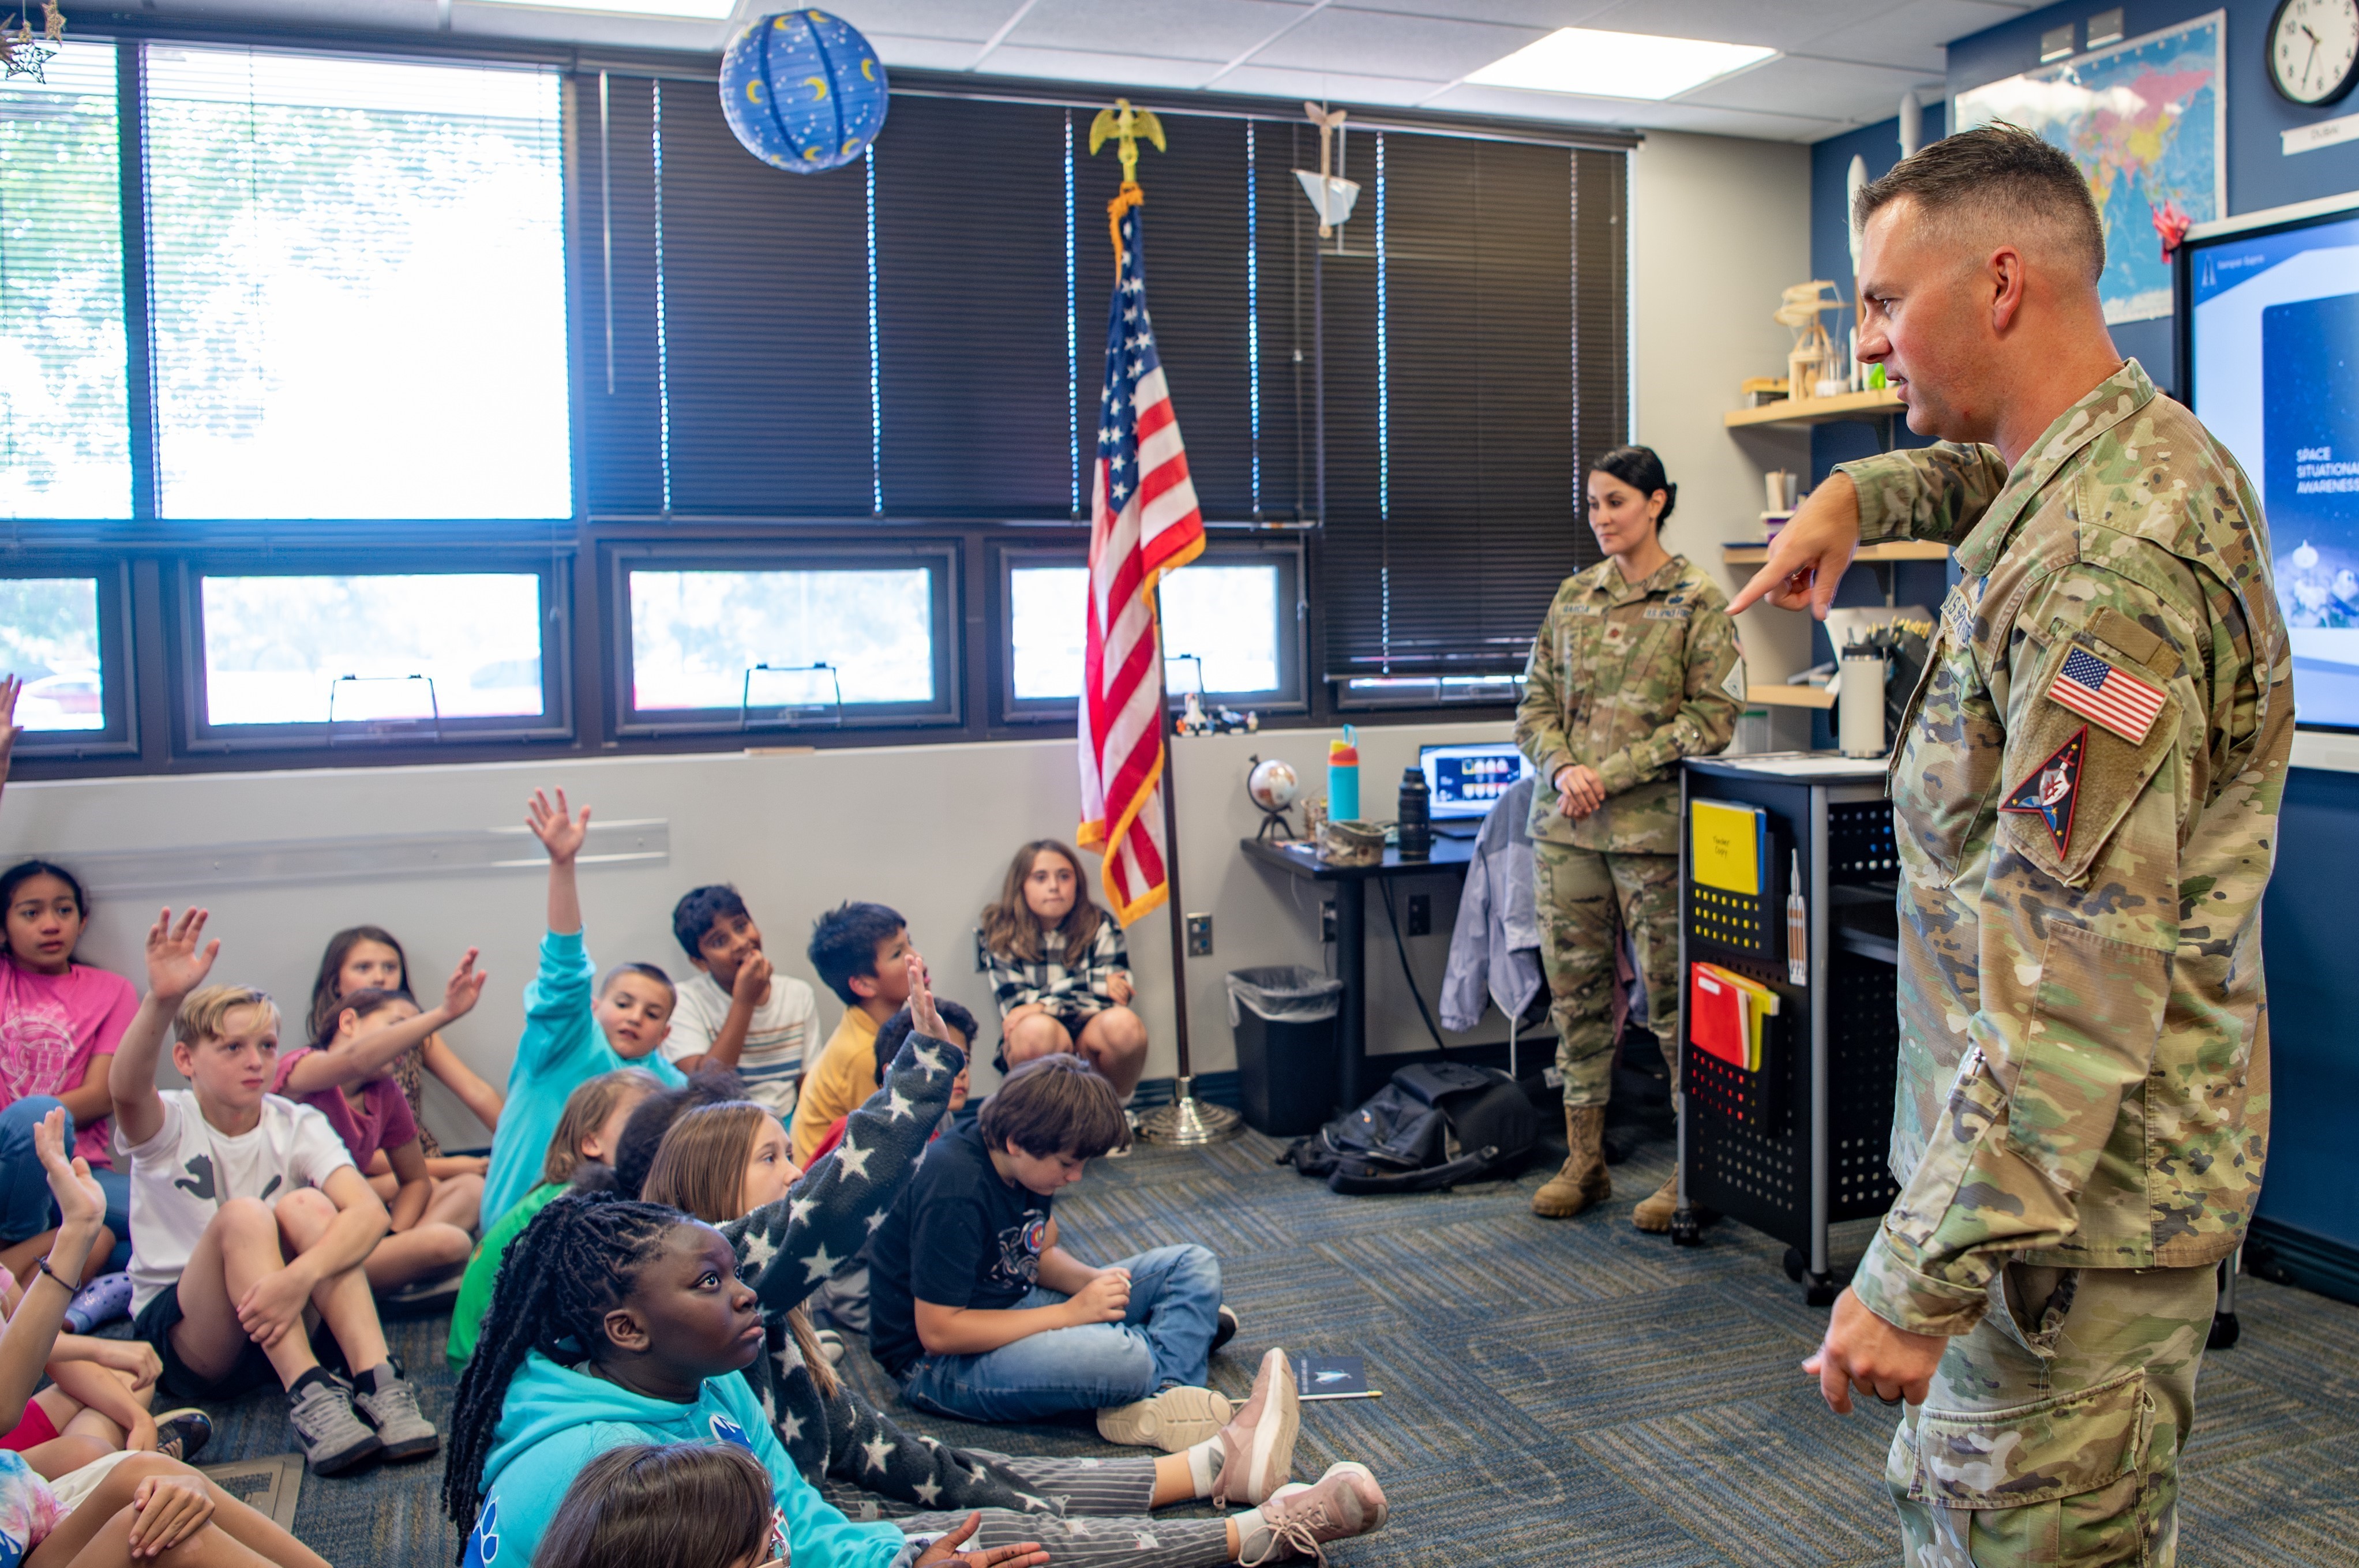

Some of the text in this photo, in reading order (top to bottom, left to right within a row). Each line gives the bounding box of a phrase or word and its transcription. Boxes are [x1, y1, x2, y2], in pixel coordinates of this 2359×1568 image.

[2296, 447, 2331, 462] SPACE
[2296, 462, 2359, 478] SITUATIONA
[1715, 845, 1727, 858] Copy
